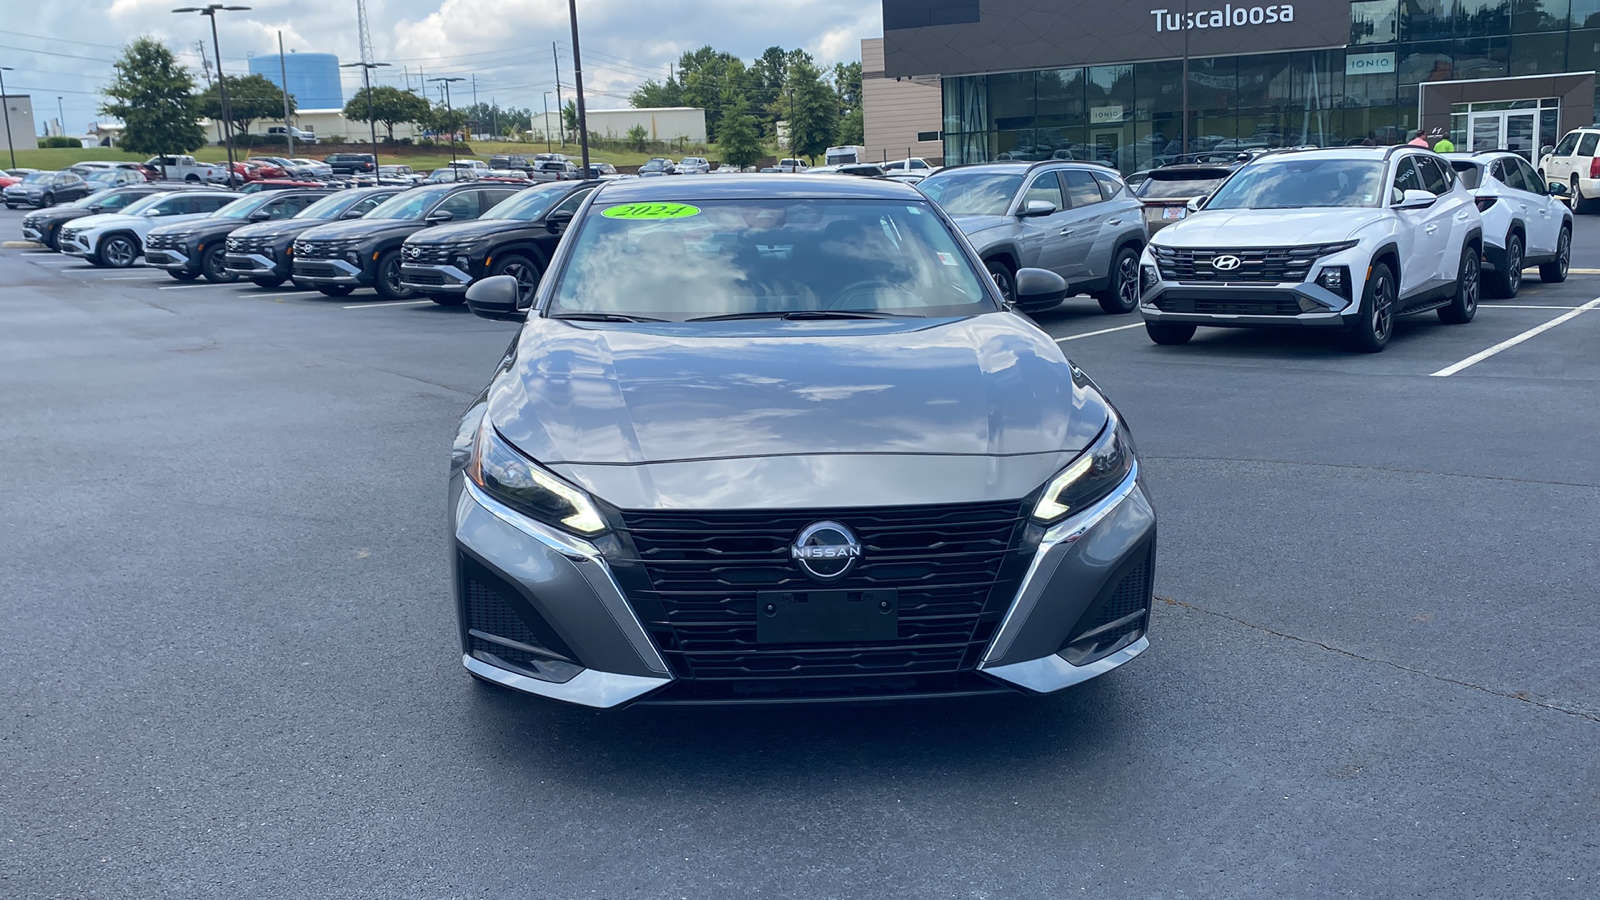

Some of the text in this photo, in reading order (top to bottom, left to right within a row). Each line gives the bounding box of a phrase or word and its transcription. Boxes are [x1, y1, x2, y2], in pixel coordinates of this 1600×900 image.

[1150, 3, 1294, 32] Tuscaloosa
[1351, 58, 1389, 69] IONIQ
[614, 205, 687, 216] 2024
[793, 546, 860, 558] NISSAN
